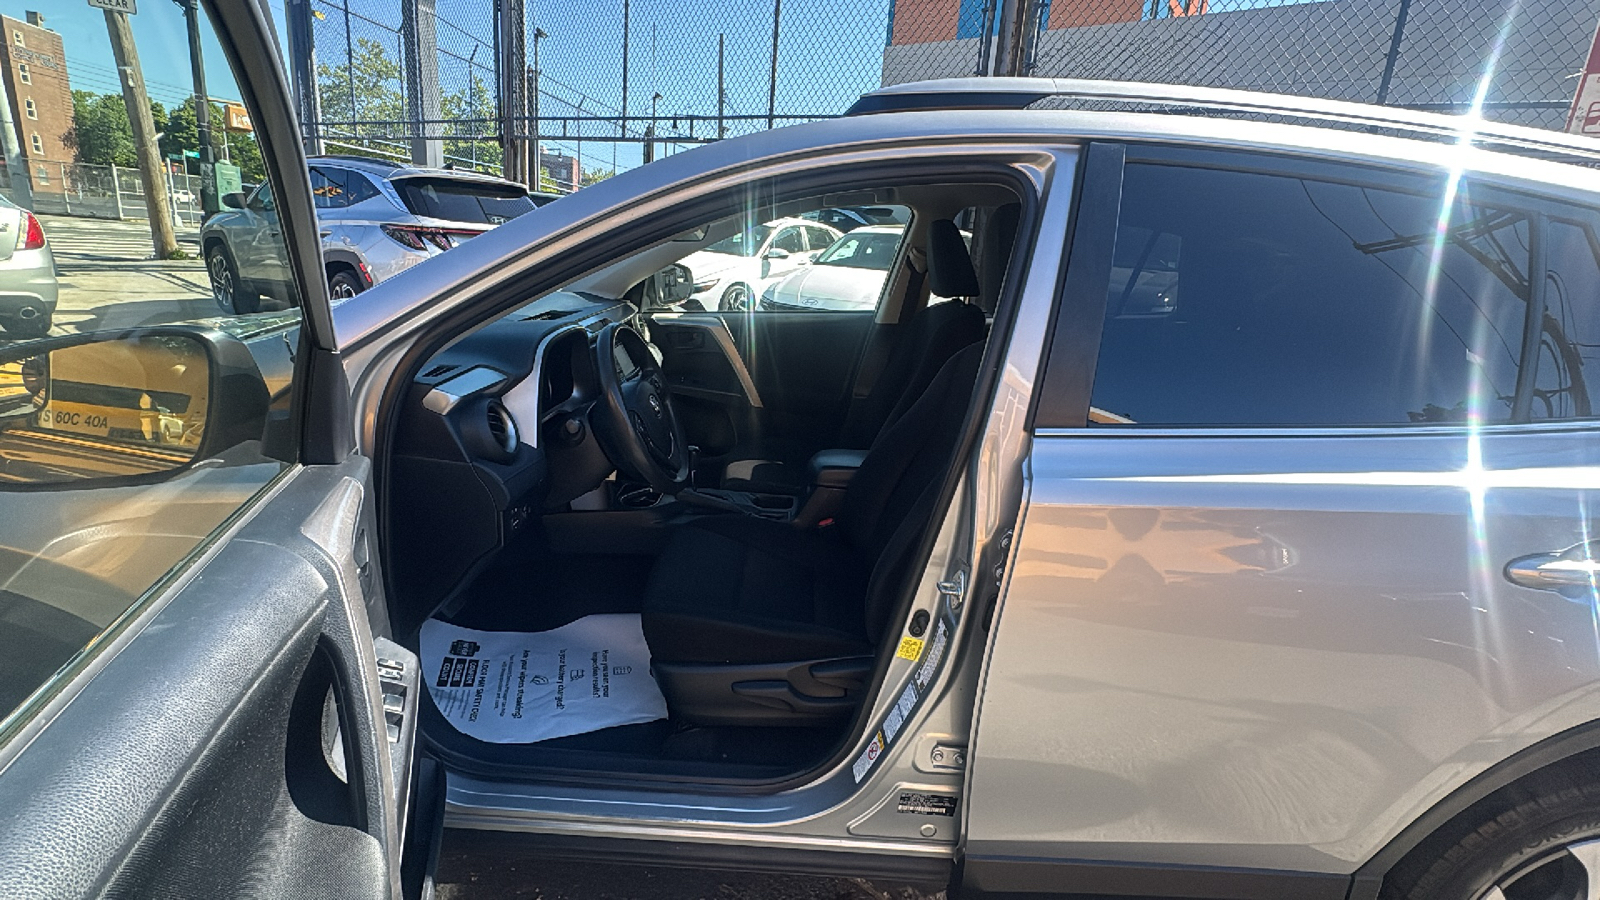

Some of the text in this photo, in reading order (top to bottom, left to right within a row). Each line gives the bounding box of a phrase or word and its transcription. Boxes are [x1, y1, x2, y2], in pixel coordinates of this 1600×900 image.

[39, 409, 108, 428] S 60C 40A
[441, 662, 451, 681] COUNT
